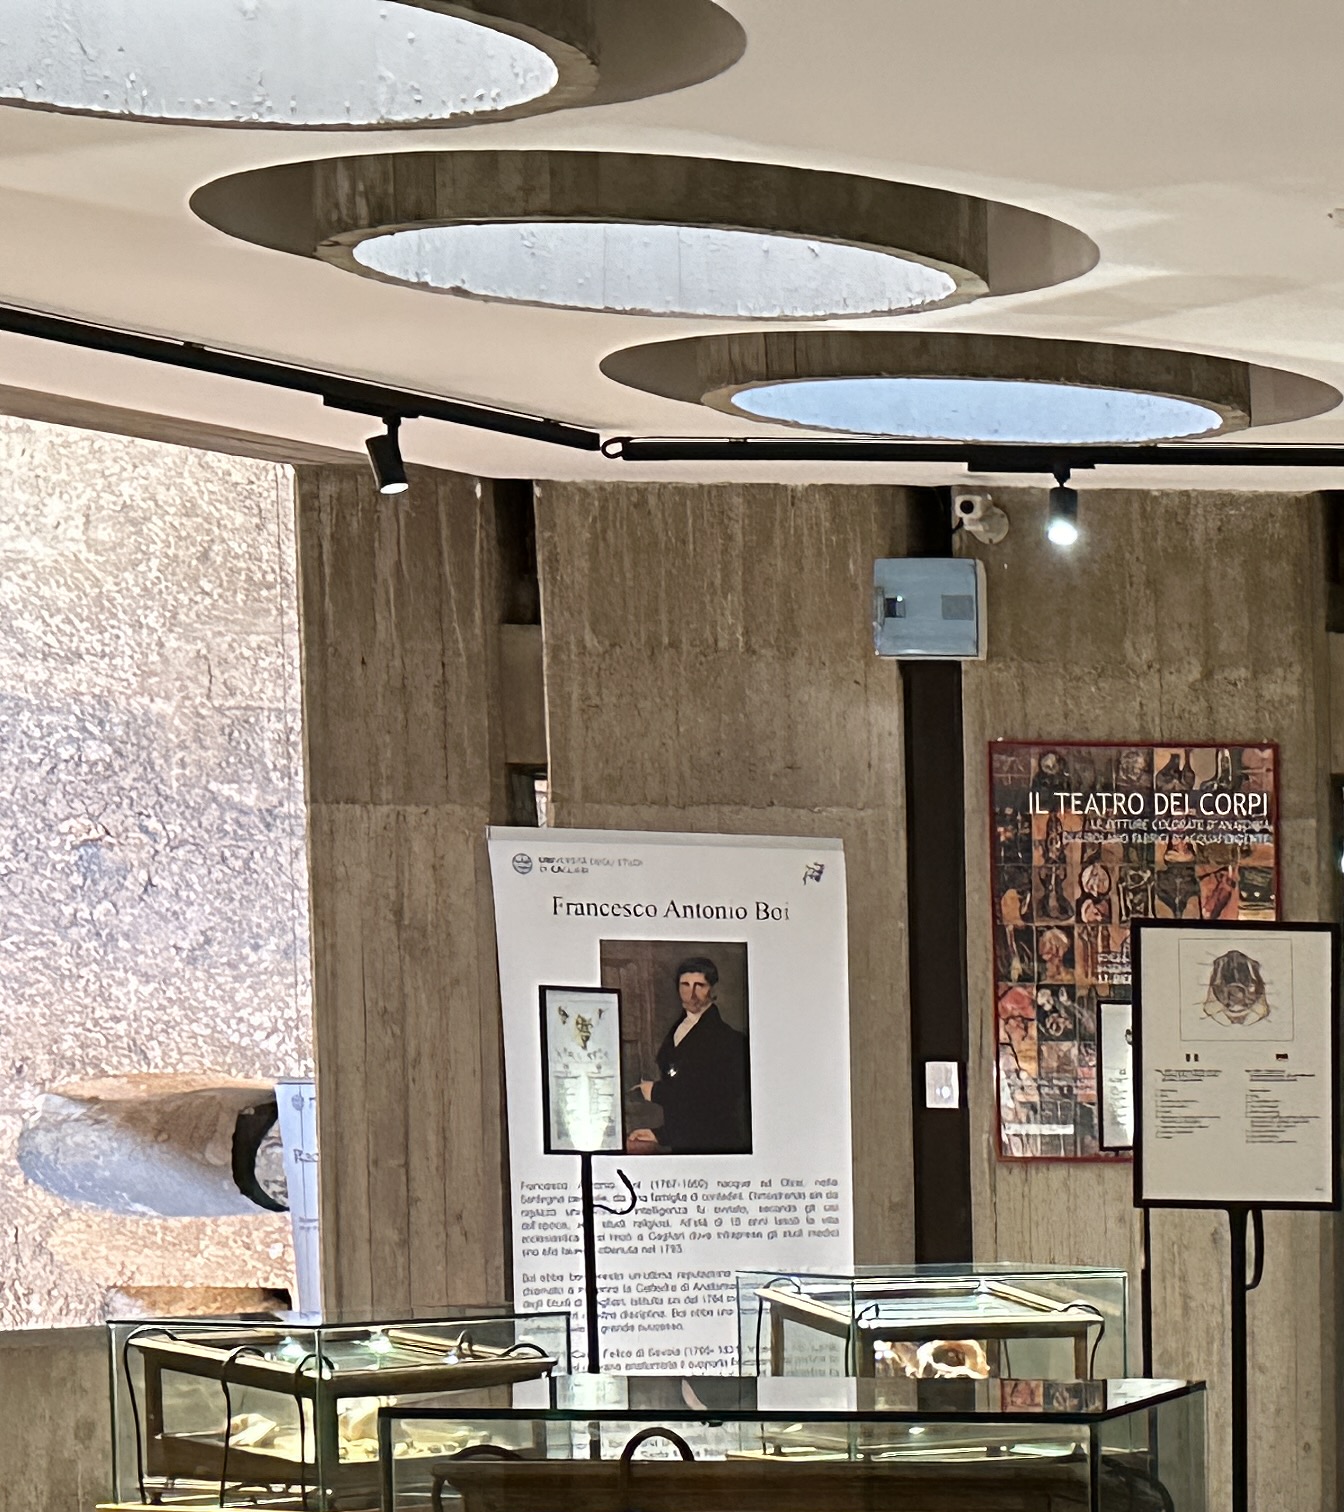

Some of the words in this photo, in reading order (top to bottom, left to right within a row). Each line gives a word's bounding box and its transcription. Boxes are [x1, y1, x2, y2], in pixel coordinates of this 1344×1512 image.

[1028, 791, 1049, 815] IL
[1053, 791, 1144, 815] TEATRO
[1154, 792, 1190, 816] DEI
[1199, 792, 1267, 816] CORPI
[552, 895, 657, 919] Francesco
[663, 899, 748, 921] Antonio
[755, 901, 790, 921] Boi
